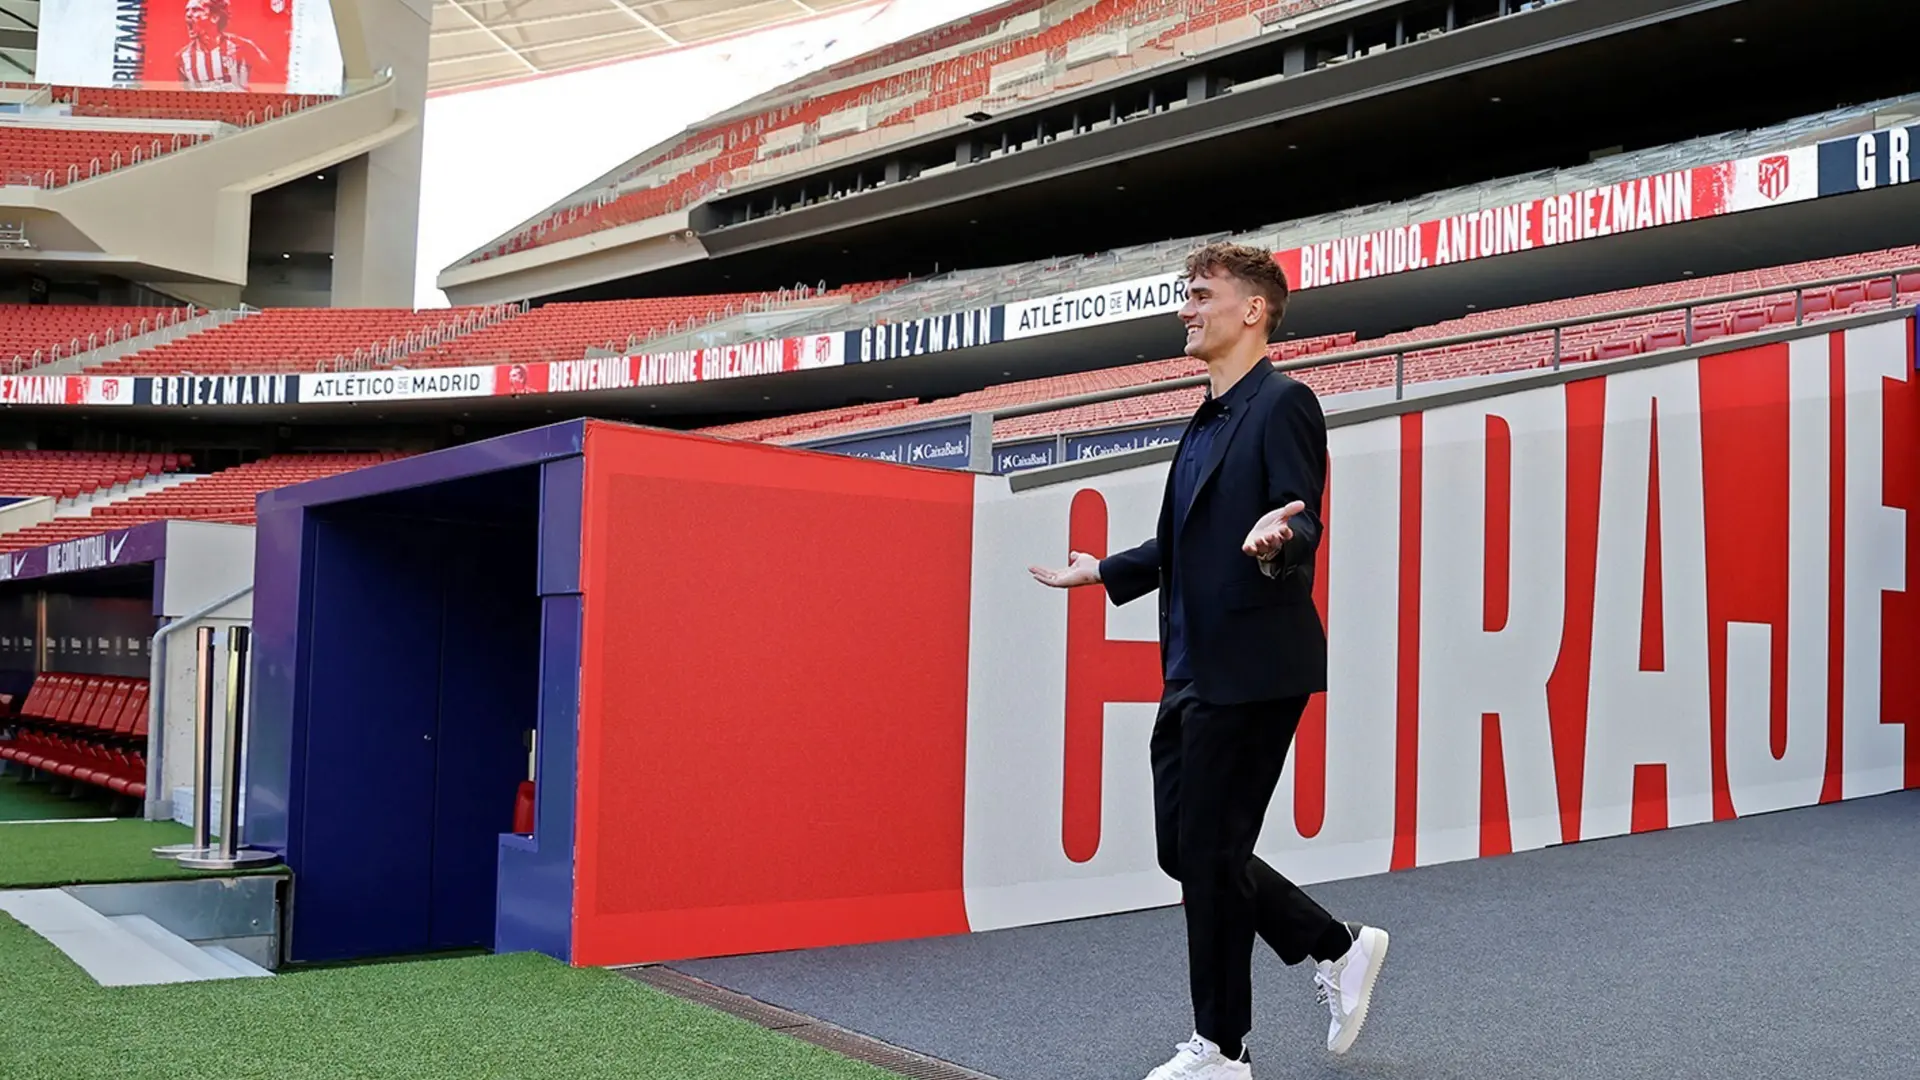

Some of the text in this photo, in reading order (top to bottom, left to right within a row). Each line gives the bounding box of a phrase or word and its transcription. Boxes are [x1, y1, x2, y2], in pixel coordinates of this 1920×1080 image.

[1856, 127, 1910, 190] GR
[1300, 169, 1693, 290] BIENVENIDO. ANTOINE GRIEZMANN
[1018, 295, 1106, 331] ATLÉTICO
[1126, 279, 1189, 312] MADR
[861, 307, 991, 363] GRIEZMANN
[151, 375, 287, 405] GRIEZMANN
[313, 374, 395, 397] ATLÉTICO
[412, 373, 481, 394] MADRID
[548, 338, 784, 392] BIENVENIDO. ANTOINE GRIEZMANN
[923, 440, 964, 459] CaixaBank
